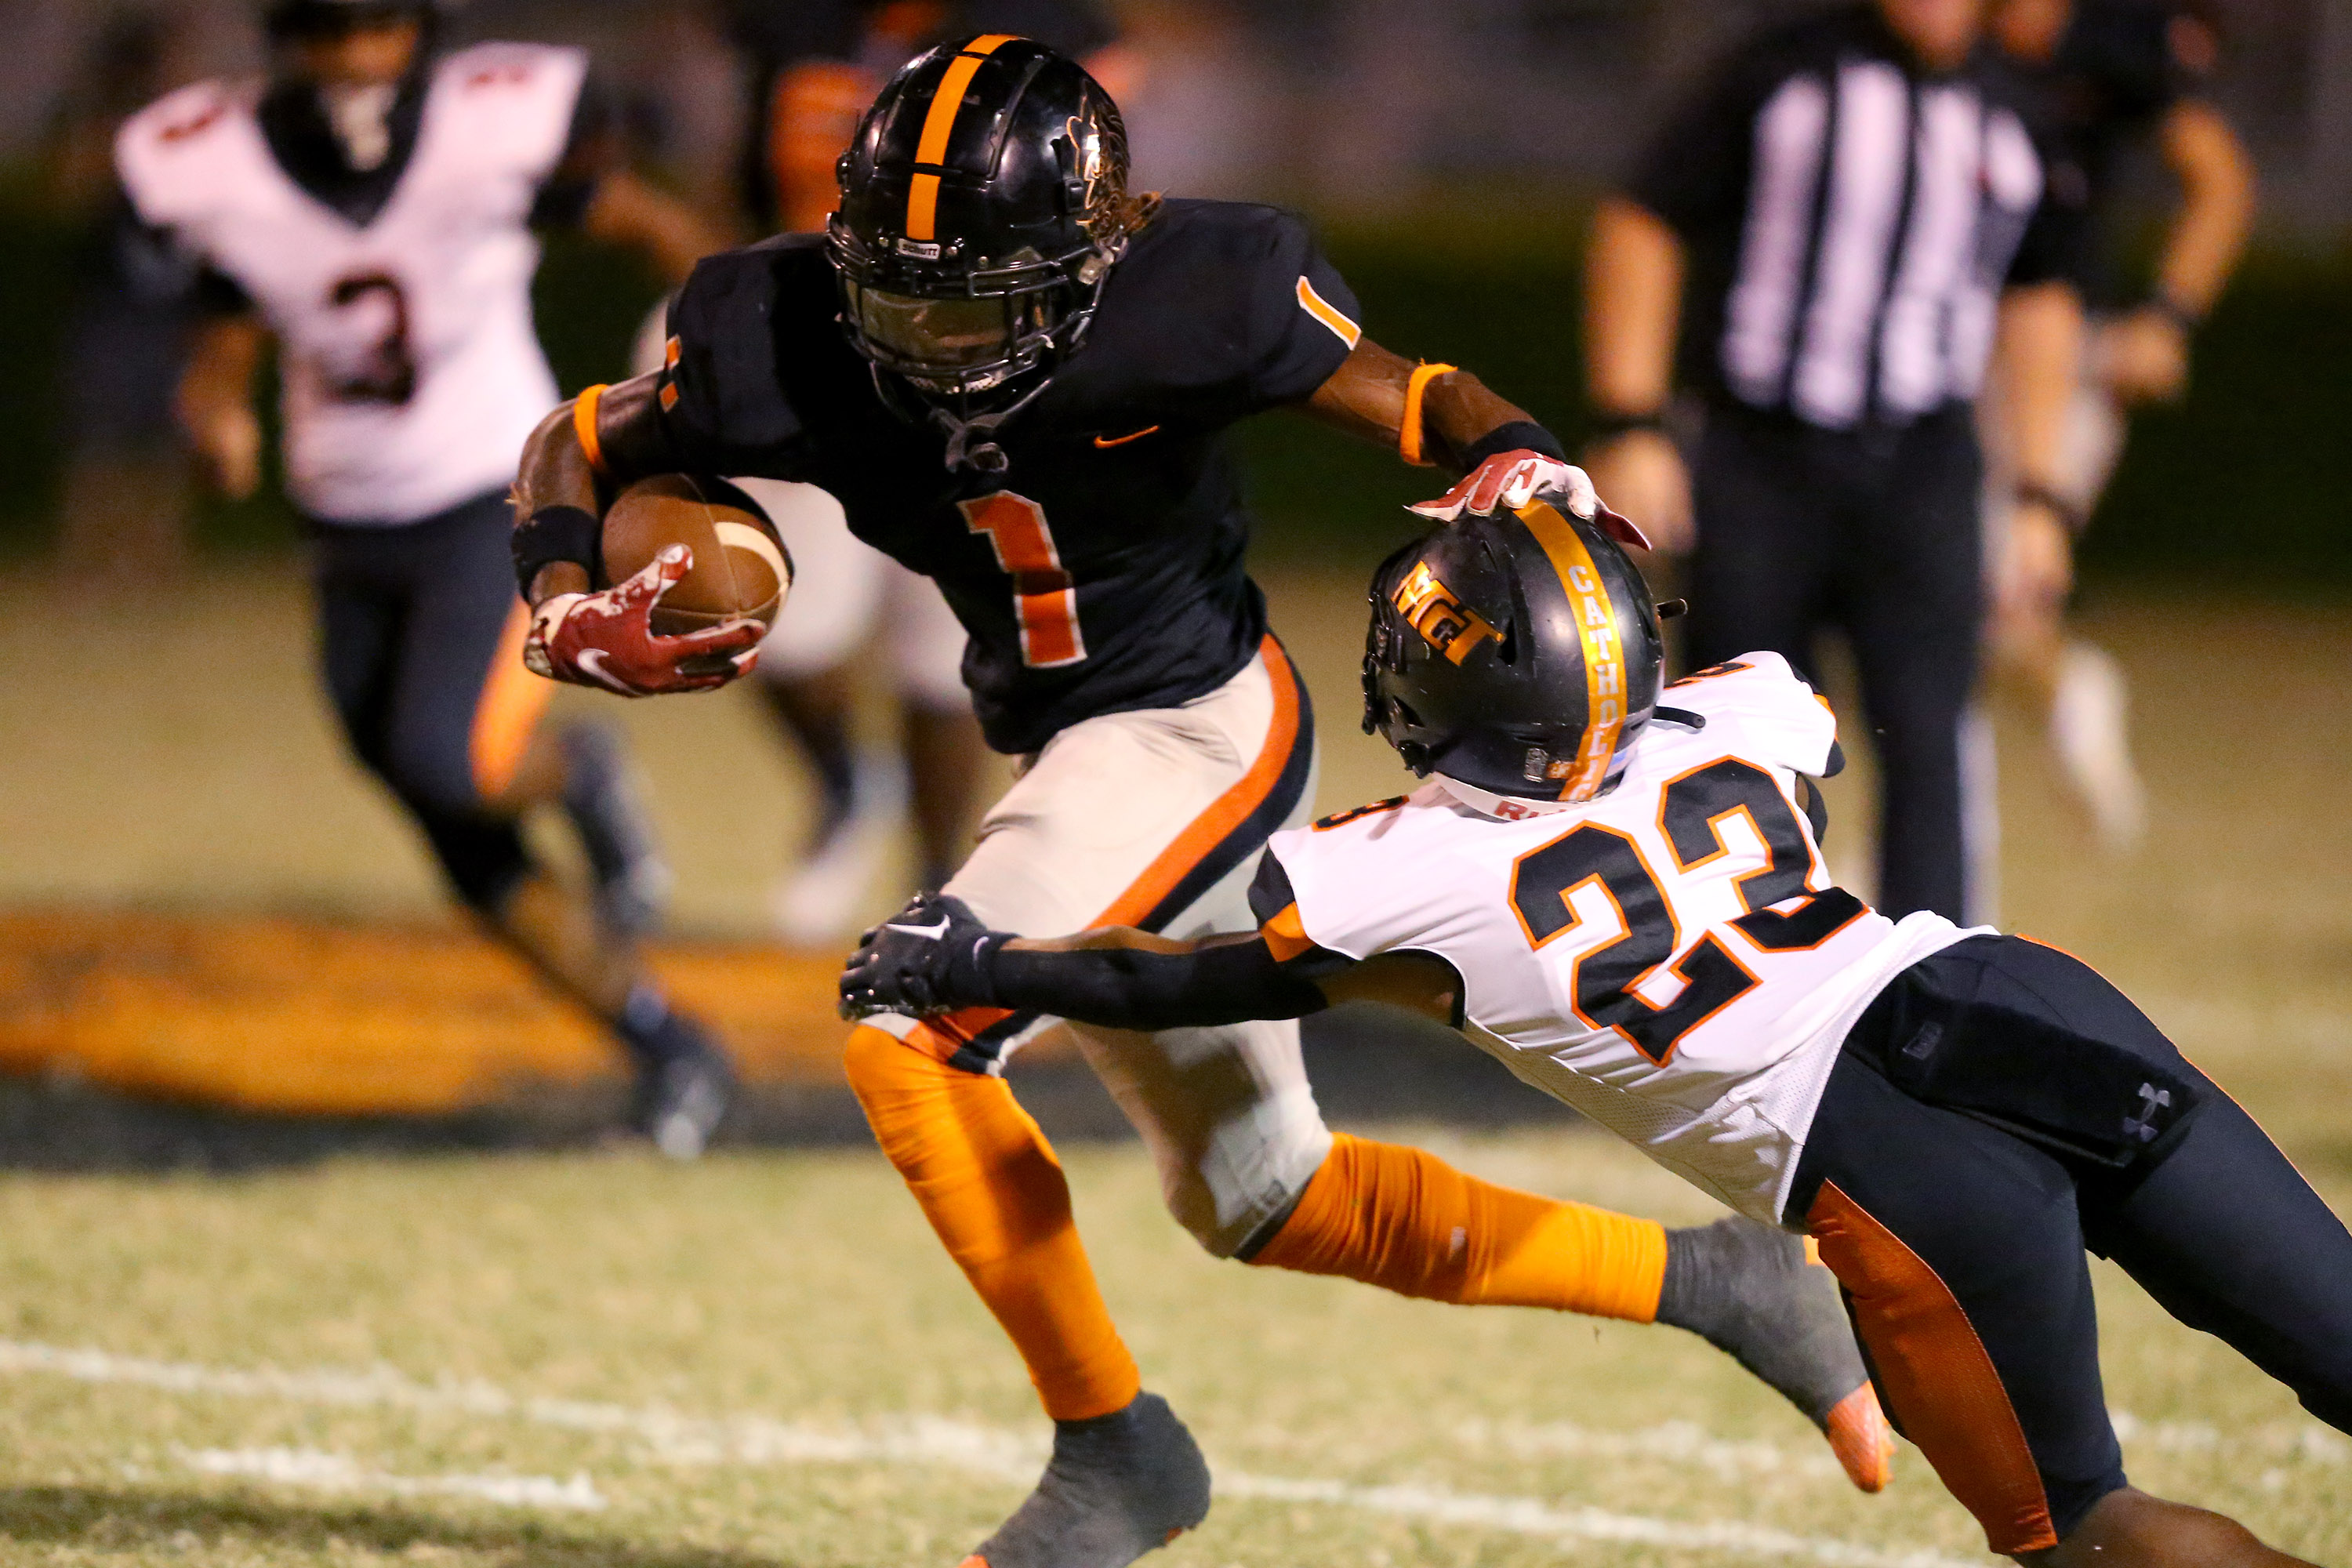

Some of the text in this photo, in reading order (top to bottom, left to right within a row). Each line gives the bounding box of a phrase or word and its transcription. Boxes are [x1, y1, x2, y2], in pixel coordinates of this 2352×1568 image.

[323, 270, 416, 408] 3
[956, 490, 1087, 668] 1
[1568, 564, 1620, 800] CATHOLIC
[1507, 753, 1871, 1069] 23
